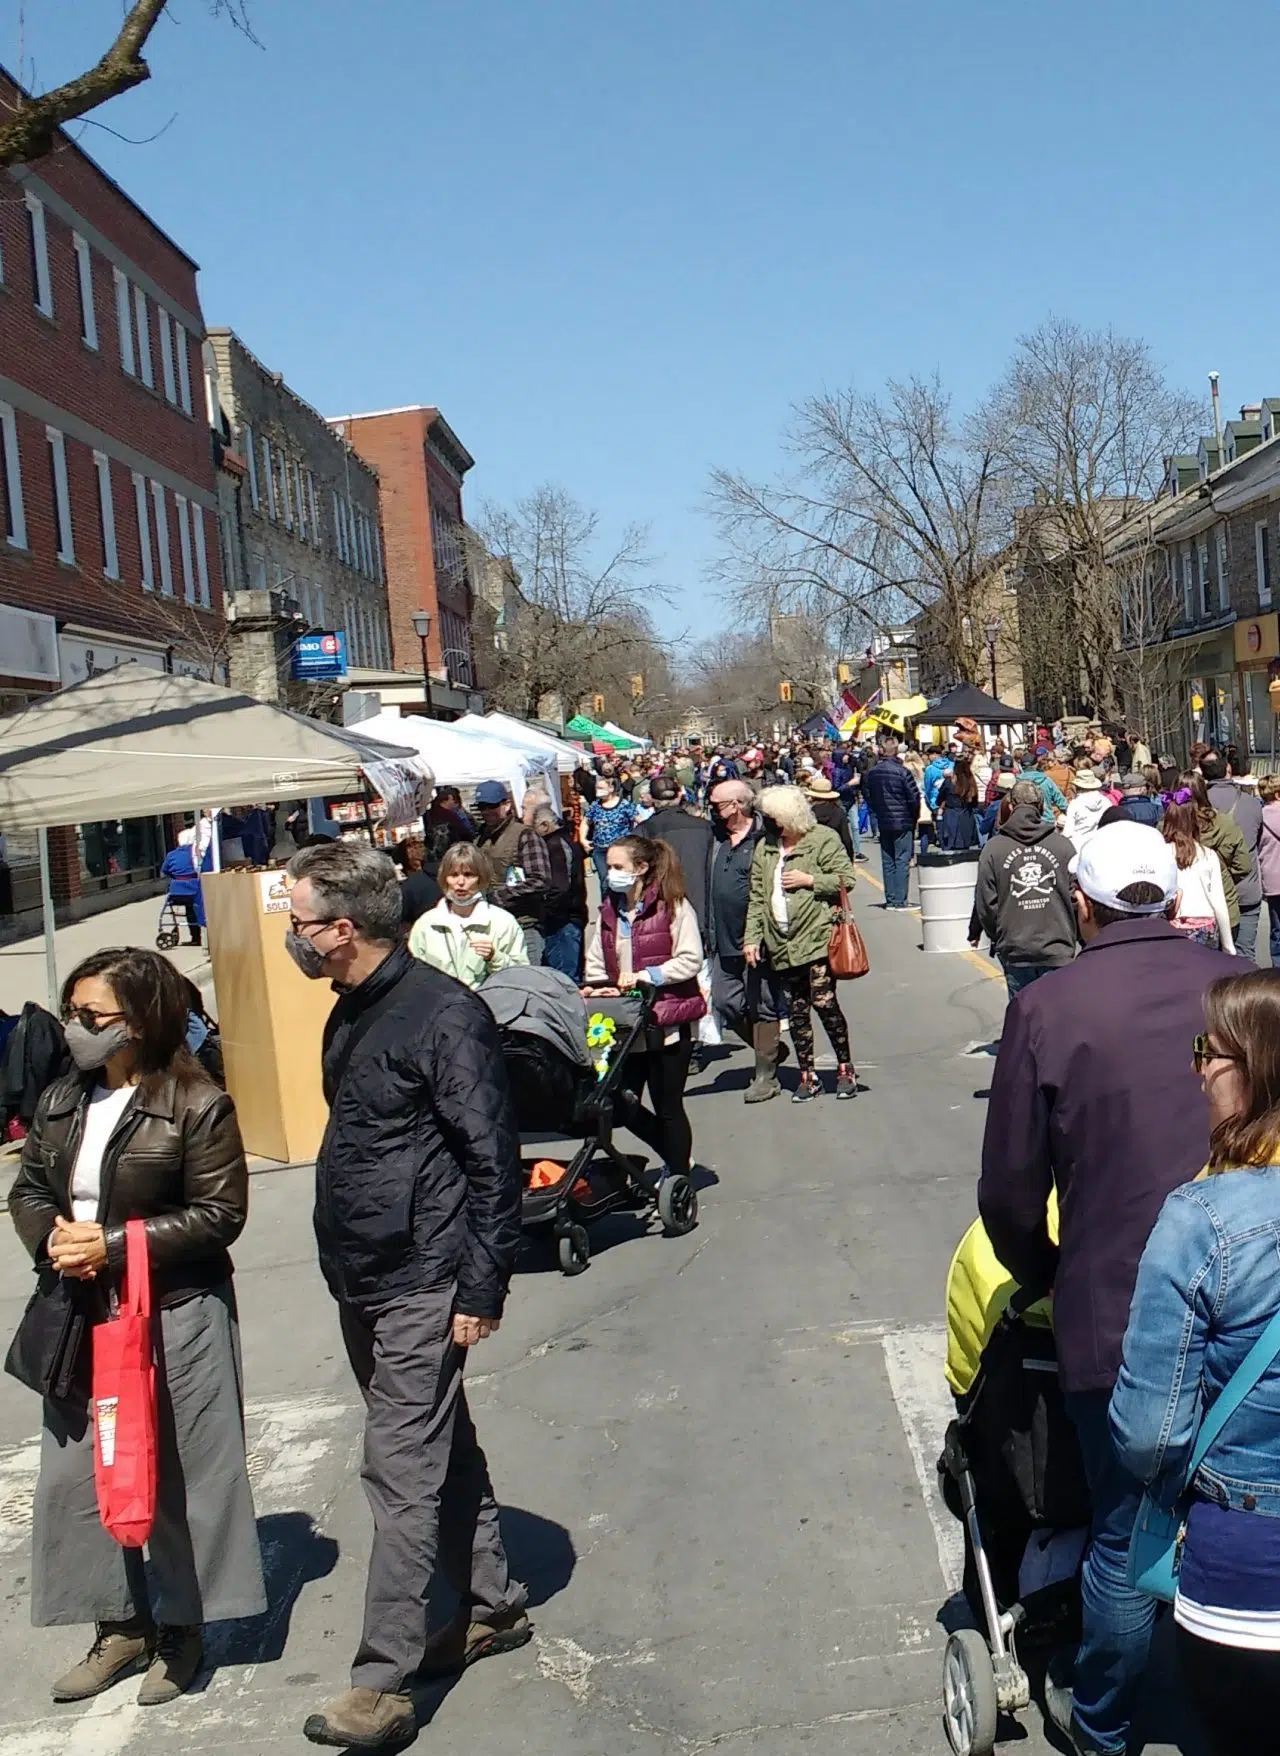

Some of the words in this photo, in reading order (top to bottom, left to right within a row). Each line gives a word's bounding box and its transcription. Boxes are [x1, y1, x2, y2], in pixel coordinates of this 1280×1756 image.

[1003, 847, 1023, 869] BIKES
[1034, 845, 1060, 869] WHEELS
[266, 901, 289, 911] SOLD
